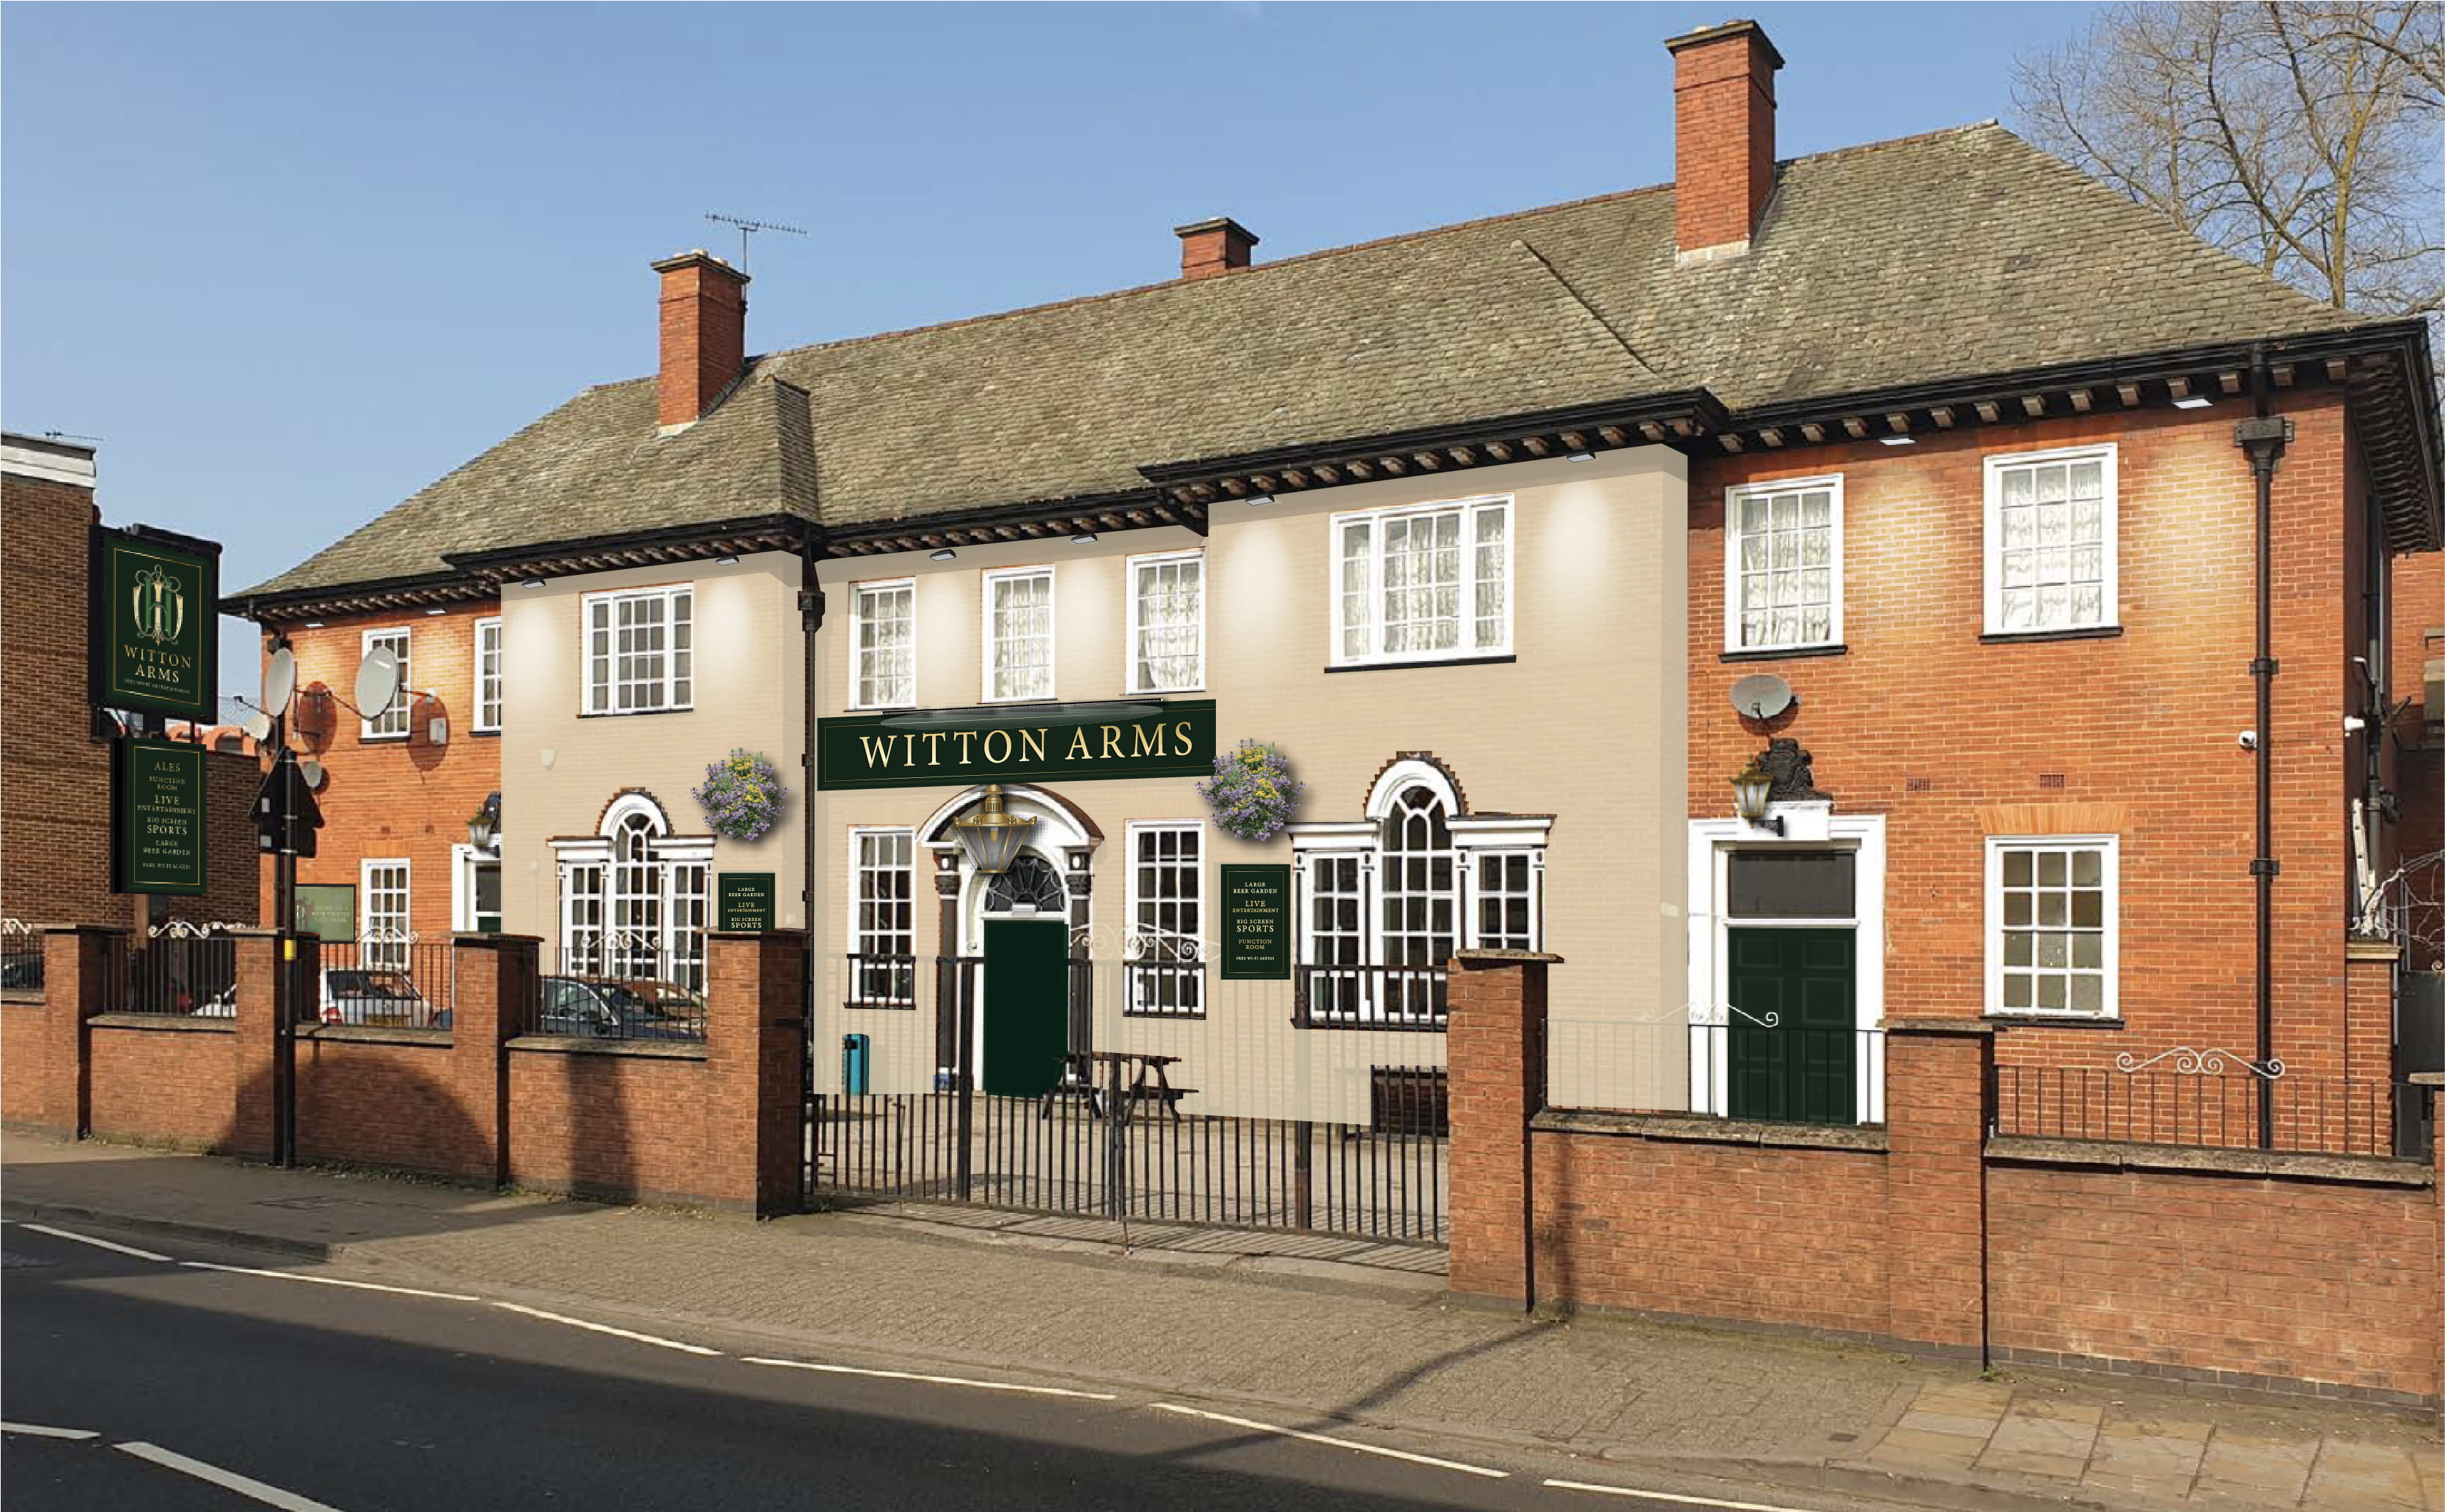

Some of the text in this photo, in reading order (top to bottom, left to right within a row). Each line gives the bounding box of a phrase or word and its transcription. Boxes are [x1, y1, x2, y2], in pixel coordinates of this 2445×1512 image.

[124, 645, 191, 669] WITTON
[135, 664, 178, 683] ARMS
[859, 721, 1193, 769] WITTON ARMS
[155, 762, 180, 771] ALES
[155, 795, 180, 805] LIVE
[138, 804, 196, 815] ENTERTAINMENT
[147, 824, 187, 835] SPORTS
[1236, 925, 1274, 933] SPORTS
